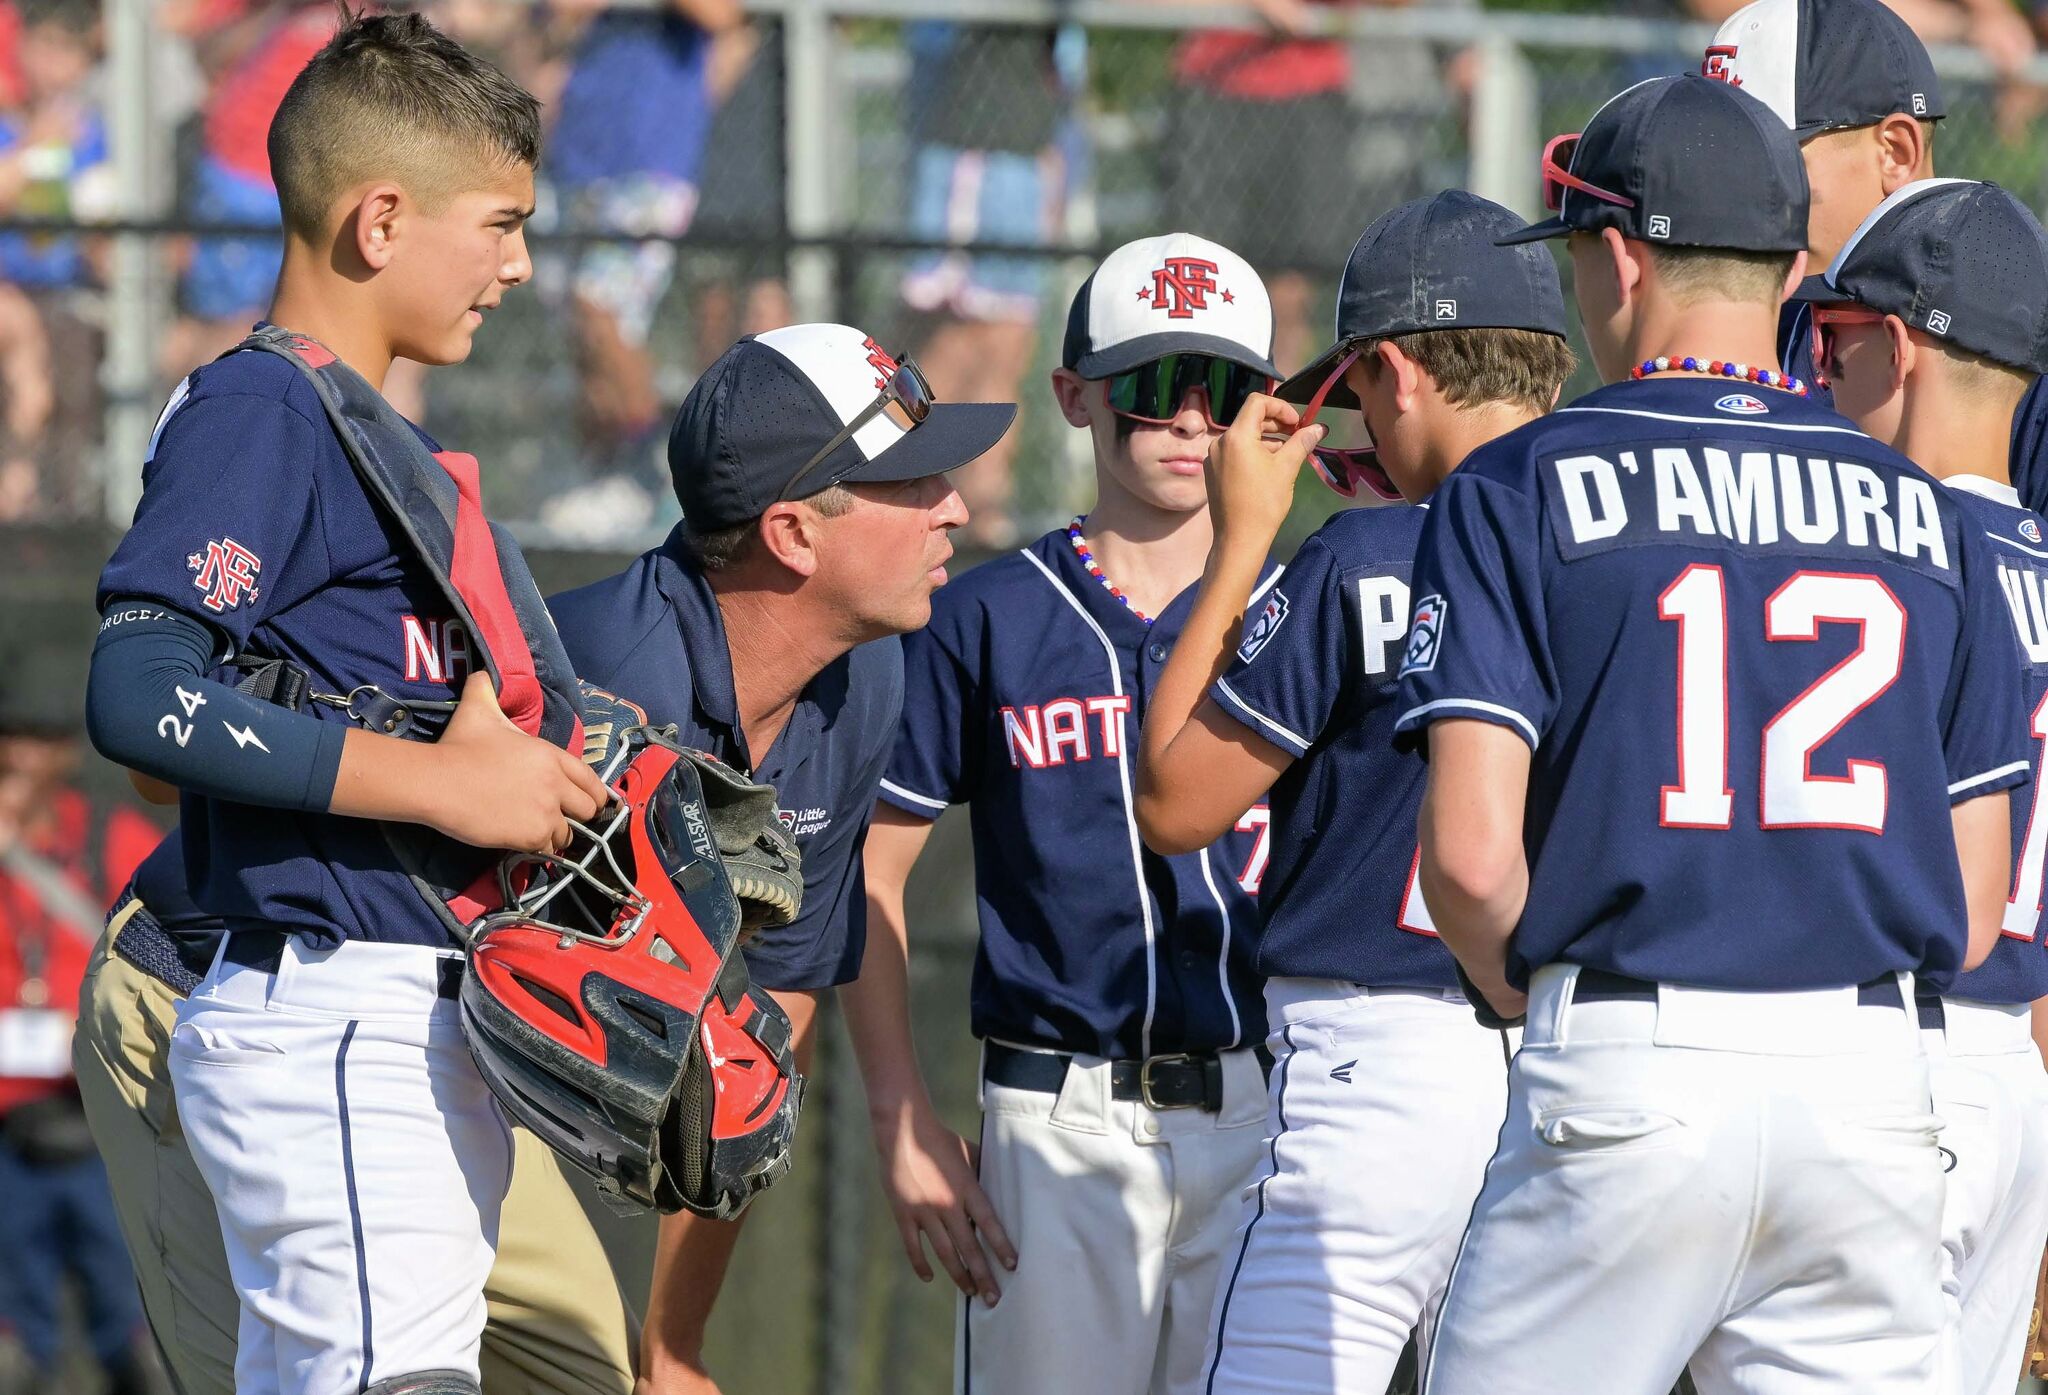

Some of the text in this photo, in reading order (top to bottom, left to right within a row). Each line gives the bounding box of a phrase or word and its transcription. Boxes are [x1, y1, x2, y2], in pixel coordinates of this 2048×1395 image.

[1555, 447, 1949, 570] D'AMURA
[157, 685, 207, 748] 24
[999, 694, 1131, 769] NAT
[1657, 563, 1908, 836] 12
[797, 807, 826, 822] Little
[1234, 804, 1270, 896] 7
